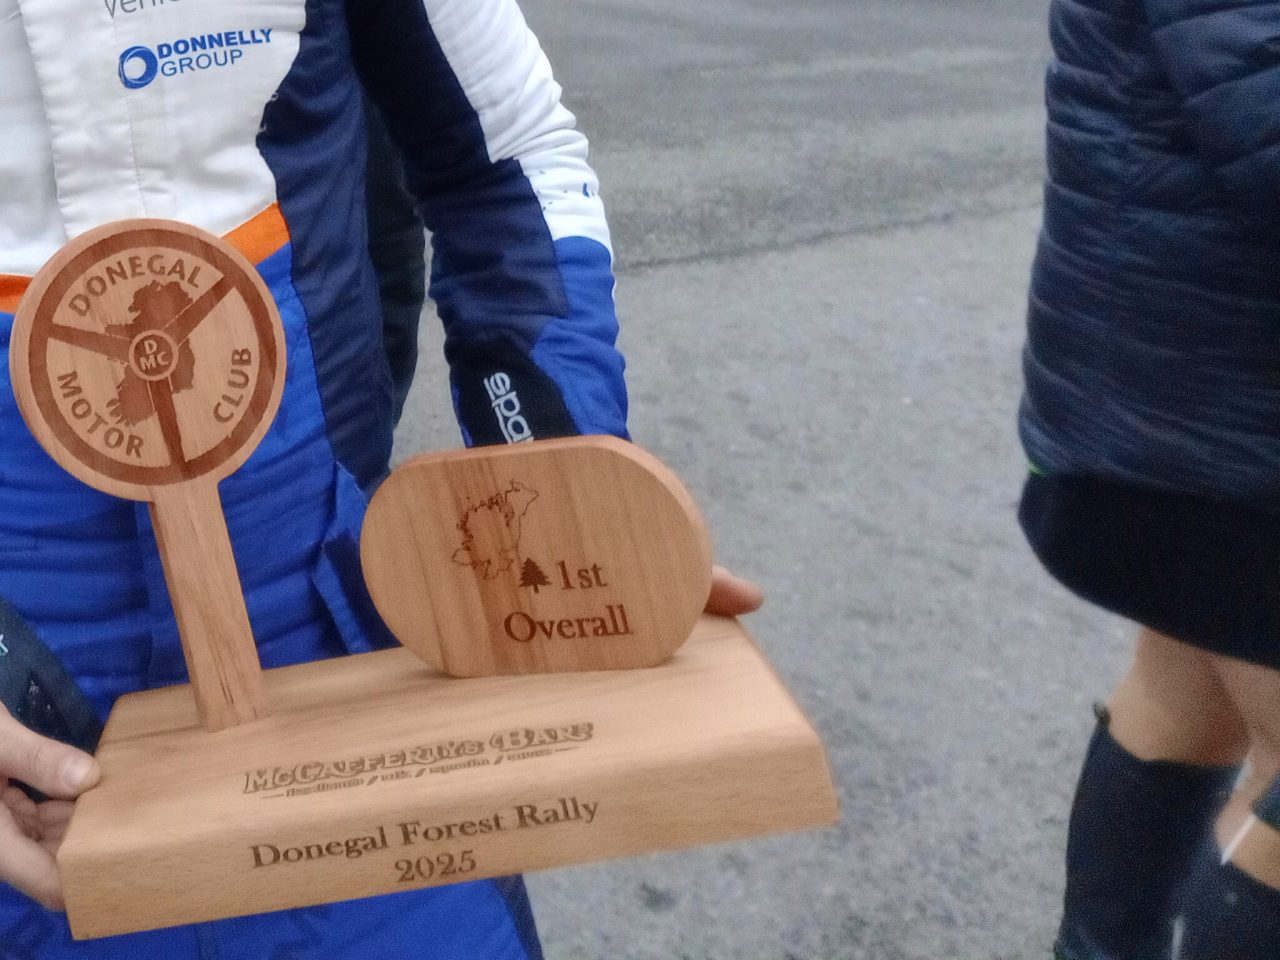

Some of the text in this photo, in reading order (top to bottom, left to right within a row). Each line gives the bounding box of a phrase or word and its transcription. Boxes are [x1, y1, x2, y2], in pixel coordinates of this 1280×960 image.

[157, 28, 273, 58] DONNELLY
[161, 49, 244, 78] GROUP
[68, 254, 202, 317] DONEGAL
[139, 351, 169, 371] MC
[145, 340, 158, 355] D
[213, 347, 252, 424] CLUB
[57, 370, 144, 458] MOTOR
[557, 560, 608, 590] 1st
[504, 604, 633, 642] Overall
[248, 796, 600, 869] Donegal Forest Rally
[394, 850, 477, 883] 2025
